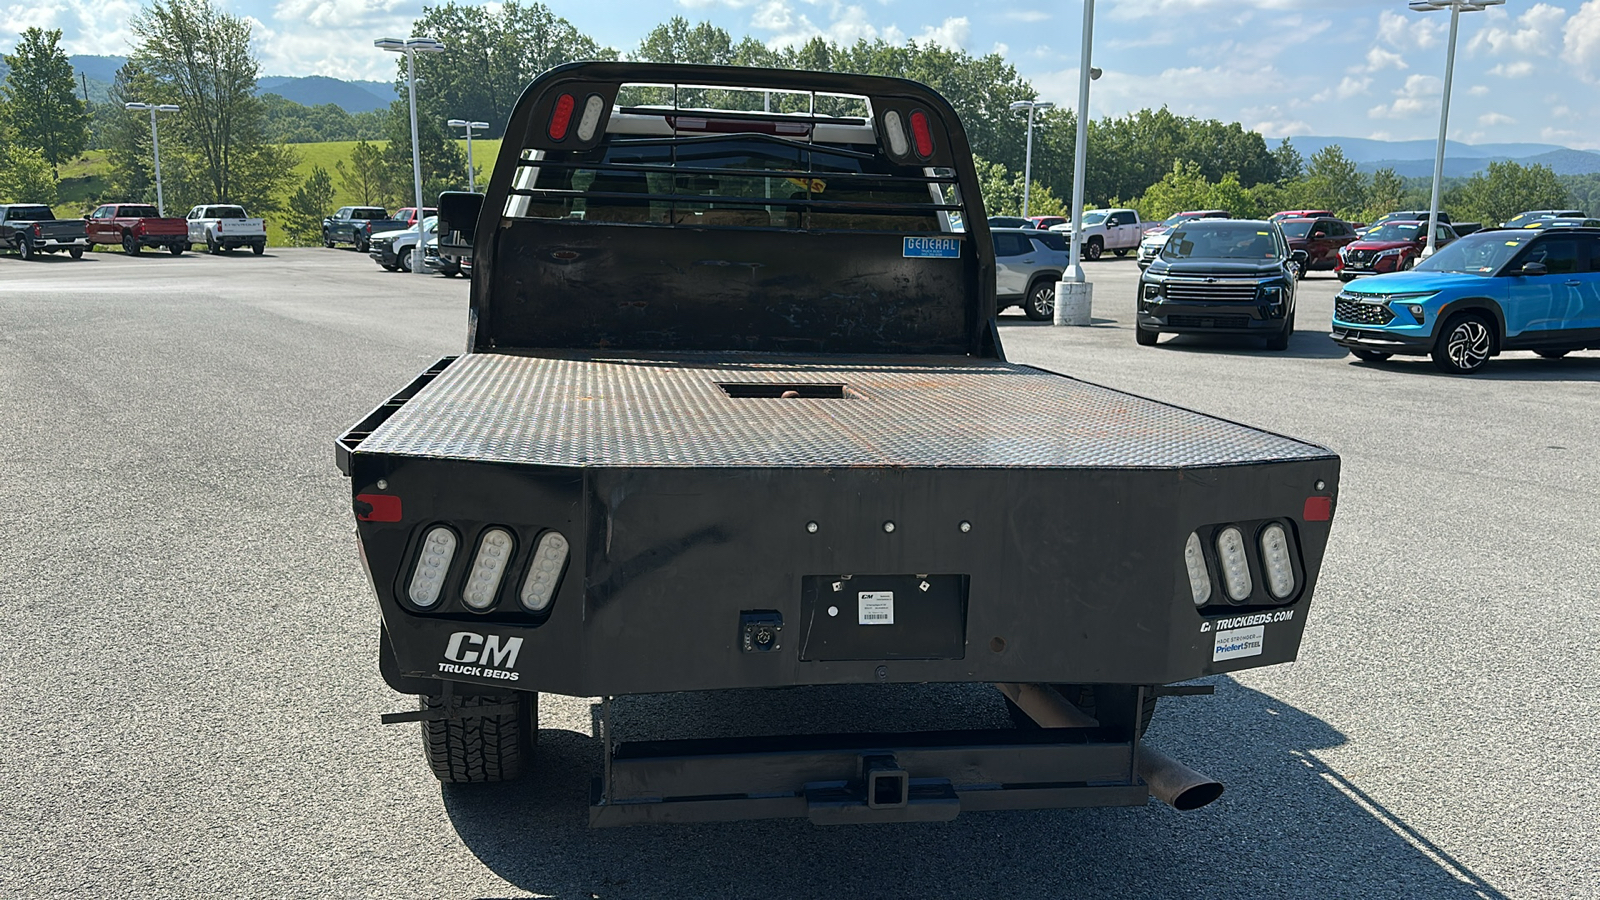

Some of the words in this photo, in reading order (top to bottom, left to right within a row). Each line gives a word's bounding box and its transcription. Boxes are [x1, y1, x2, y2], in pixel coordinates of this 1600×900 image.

[908, 238, 956, 250] GENERAL
[1231, 634, 1256, 643] STRONGER
[444, 631, 524, 669] CM
[438, 662, 482, 677] TRUCK
[483, 668, 520, 681] BEDS
